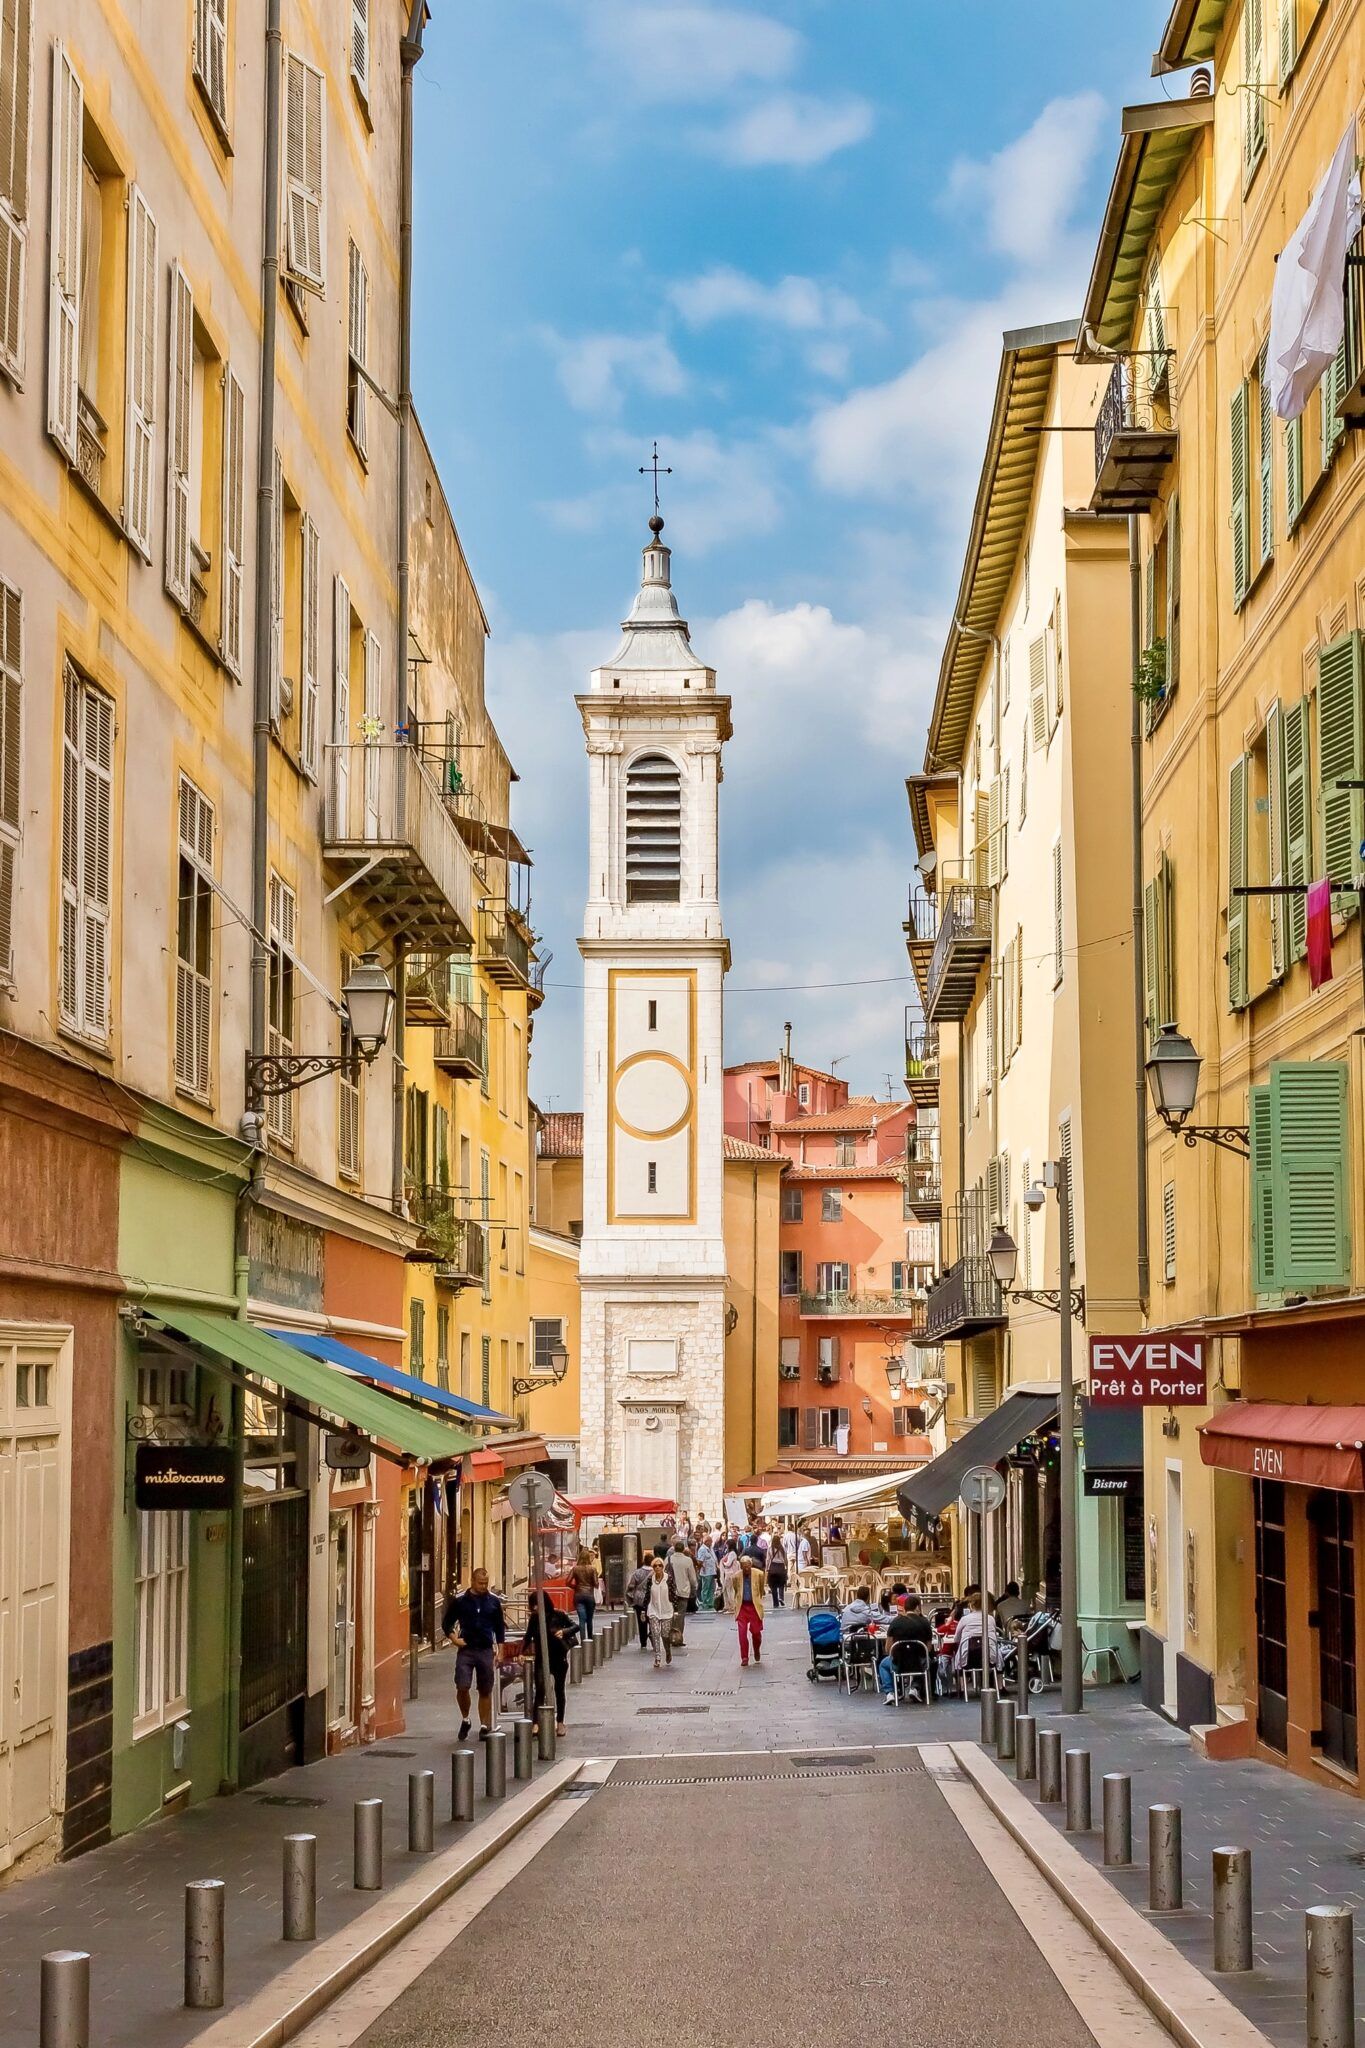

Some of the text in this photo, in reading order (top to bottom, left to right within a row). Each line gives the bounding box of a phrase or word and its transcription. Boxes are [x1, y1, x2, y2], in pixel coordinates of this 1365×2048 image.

[1093, 1343, 1202, 1371] EVEN
[1091, 1378, 1204, 1396] Prêt à Porter
[1254, 1447, 1283, 1475] EVEN
[145, 1467, 226, 1484] mistercanne
[1092, 1478, 1128, 1489] Bistrot
